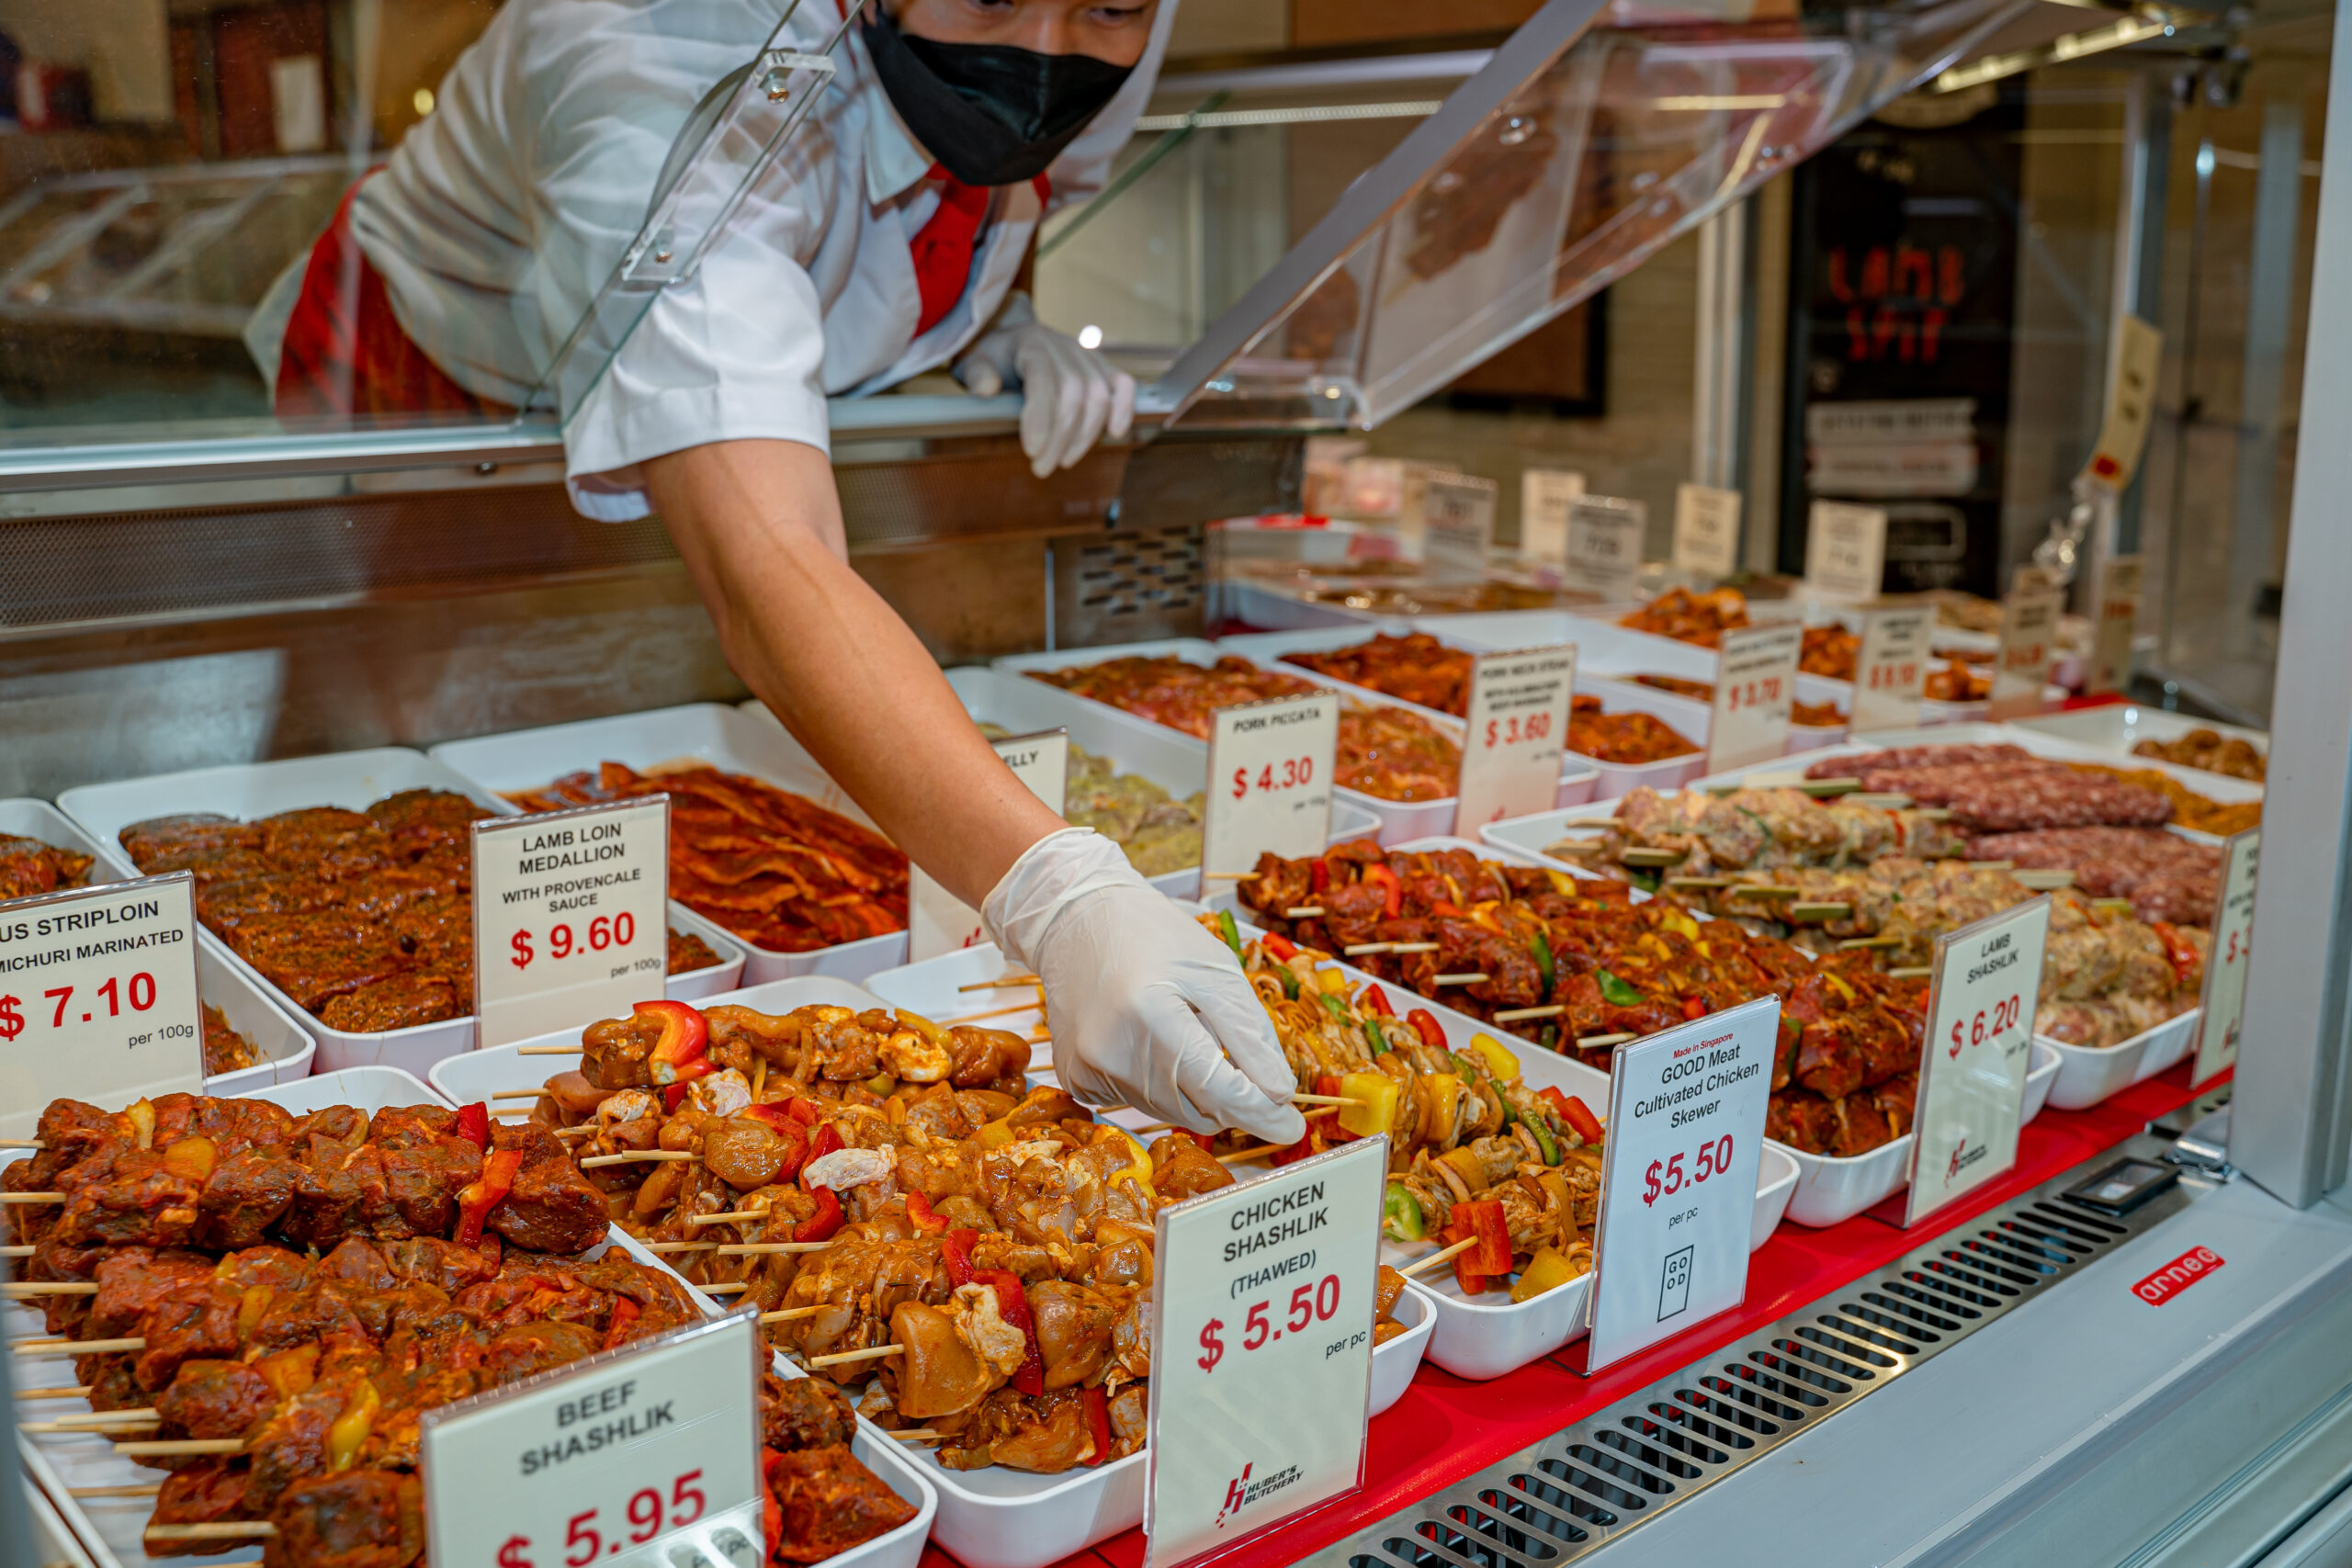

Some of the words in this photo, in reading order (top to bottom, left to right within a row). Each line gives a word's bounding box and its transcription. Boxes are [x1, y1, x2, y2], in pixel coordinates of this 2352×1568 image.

[1233, 717, 1267, 734] PORK
[1271, 707, 1320, 727] PICCATA
[1485, 718, 1498, 750] $
[1505, 710, 1552, 746] 3.60
[1231, 766, 1248, 803] $
[1257, 755, 1314, 792] 4.30
[523, 830, 574, 852] LAMB
[581, 823, 622, 843] LOIN
[519, 843, 625, 874] MEDALLION
[503, 886, 540, 904] WITH
[544, 868, 641, 897] PROVENCALE
[549, 893, 598, 913] SAUCE
[37, 900, 159, 936] STRIPLOIN
[77, 929, 184, 960] MARINATED
[511, 928, 534, 971] $
[549, 911, 635, 959] 9.60
[1981, 932, 2011, 958] LAMB
[611, 964, 629, 978] per
[634, 958, 662, 971] 100g
[1966, 948, 2019, 985] SHASHLIK
[0, 994, 25, 1042] $
[44, 971, 156, 1028] 7.10
[129, 1032, 152, 1049] per
[158, 1024, 194, 1041] 100g
[1949, 1019, 1964, 1061] $
[1971, 994, 2019, 1046] 6.20
[1662, 1055, 1705, 1084] GOOD
[1708, 1043, 1741, 1068] Meat
[1673, 1048, 1690, 1059] Made
[1692, 1043, 1700, 1053] in
[1700, 1033, 1734, 1050] Singapore
[1634, 1079, 1703, 1119] Cultivated
[1706, 1063, 1759, 1091] Chicken
[1670, 1100, 1721, 1129] Skewer
[1642, 1134, 1734, 1208] $5.50
[1230, 1181, 1324, 1231] CHICKEN
[1668, 1211, 1685, 1230] per
[1686, 1206, 1699, 1223] pc
[1223, 1207, 1329, 1263] SHASHLIK
[1230, 1249, 1317, 1300] (THAWED)
[1197, 1317, 1225, 1374] $
[1243, 1273, 1340, 1351] 5.50
[1326, 1337, 1348, 1359] per
[1350, 1330, 1367, 1348] pc
[557, 1380, 639, 1429] BEEF
[519, 1399, 675, 1477] SHASHLIK
[1243, 1470, 1305, 1506] BUTCHERY
[1247, 1464, 1297, 1495] HUBER'S
[564, 1467, 707, 1568] 5.95
